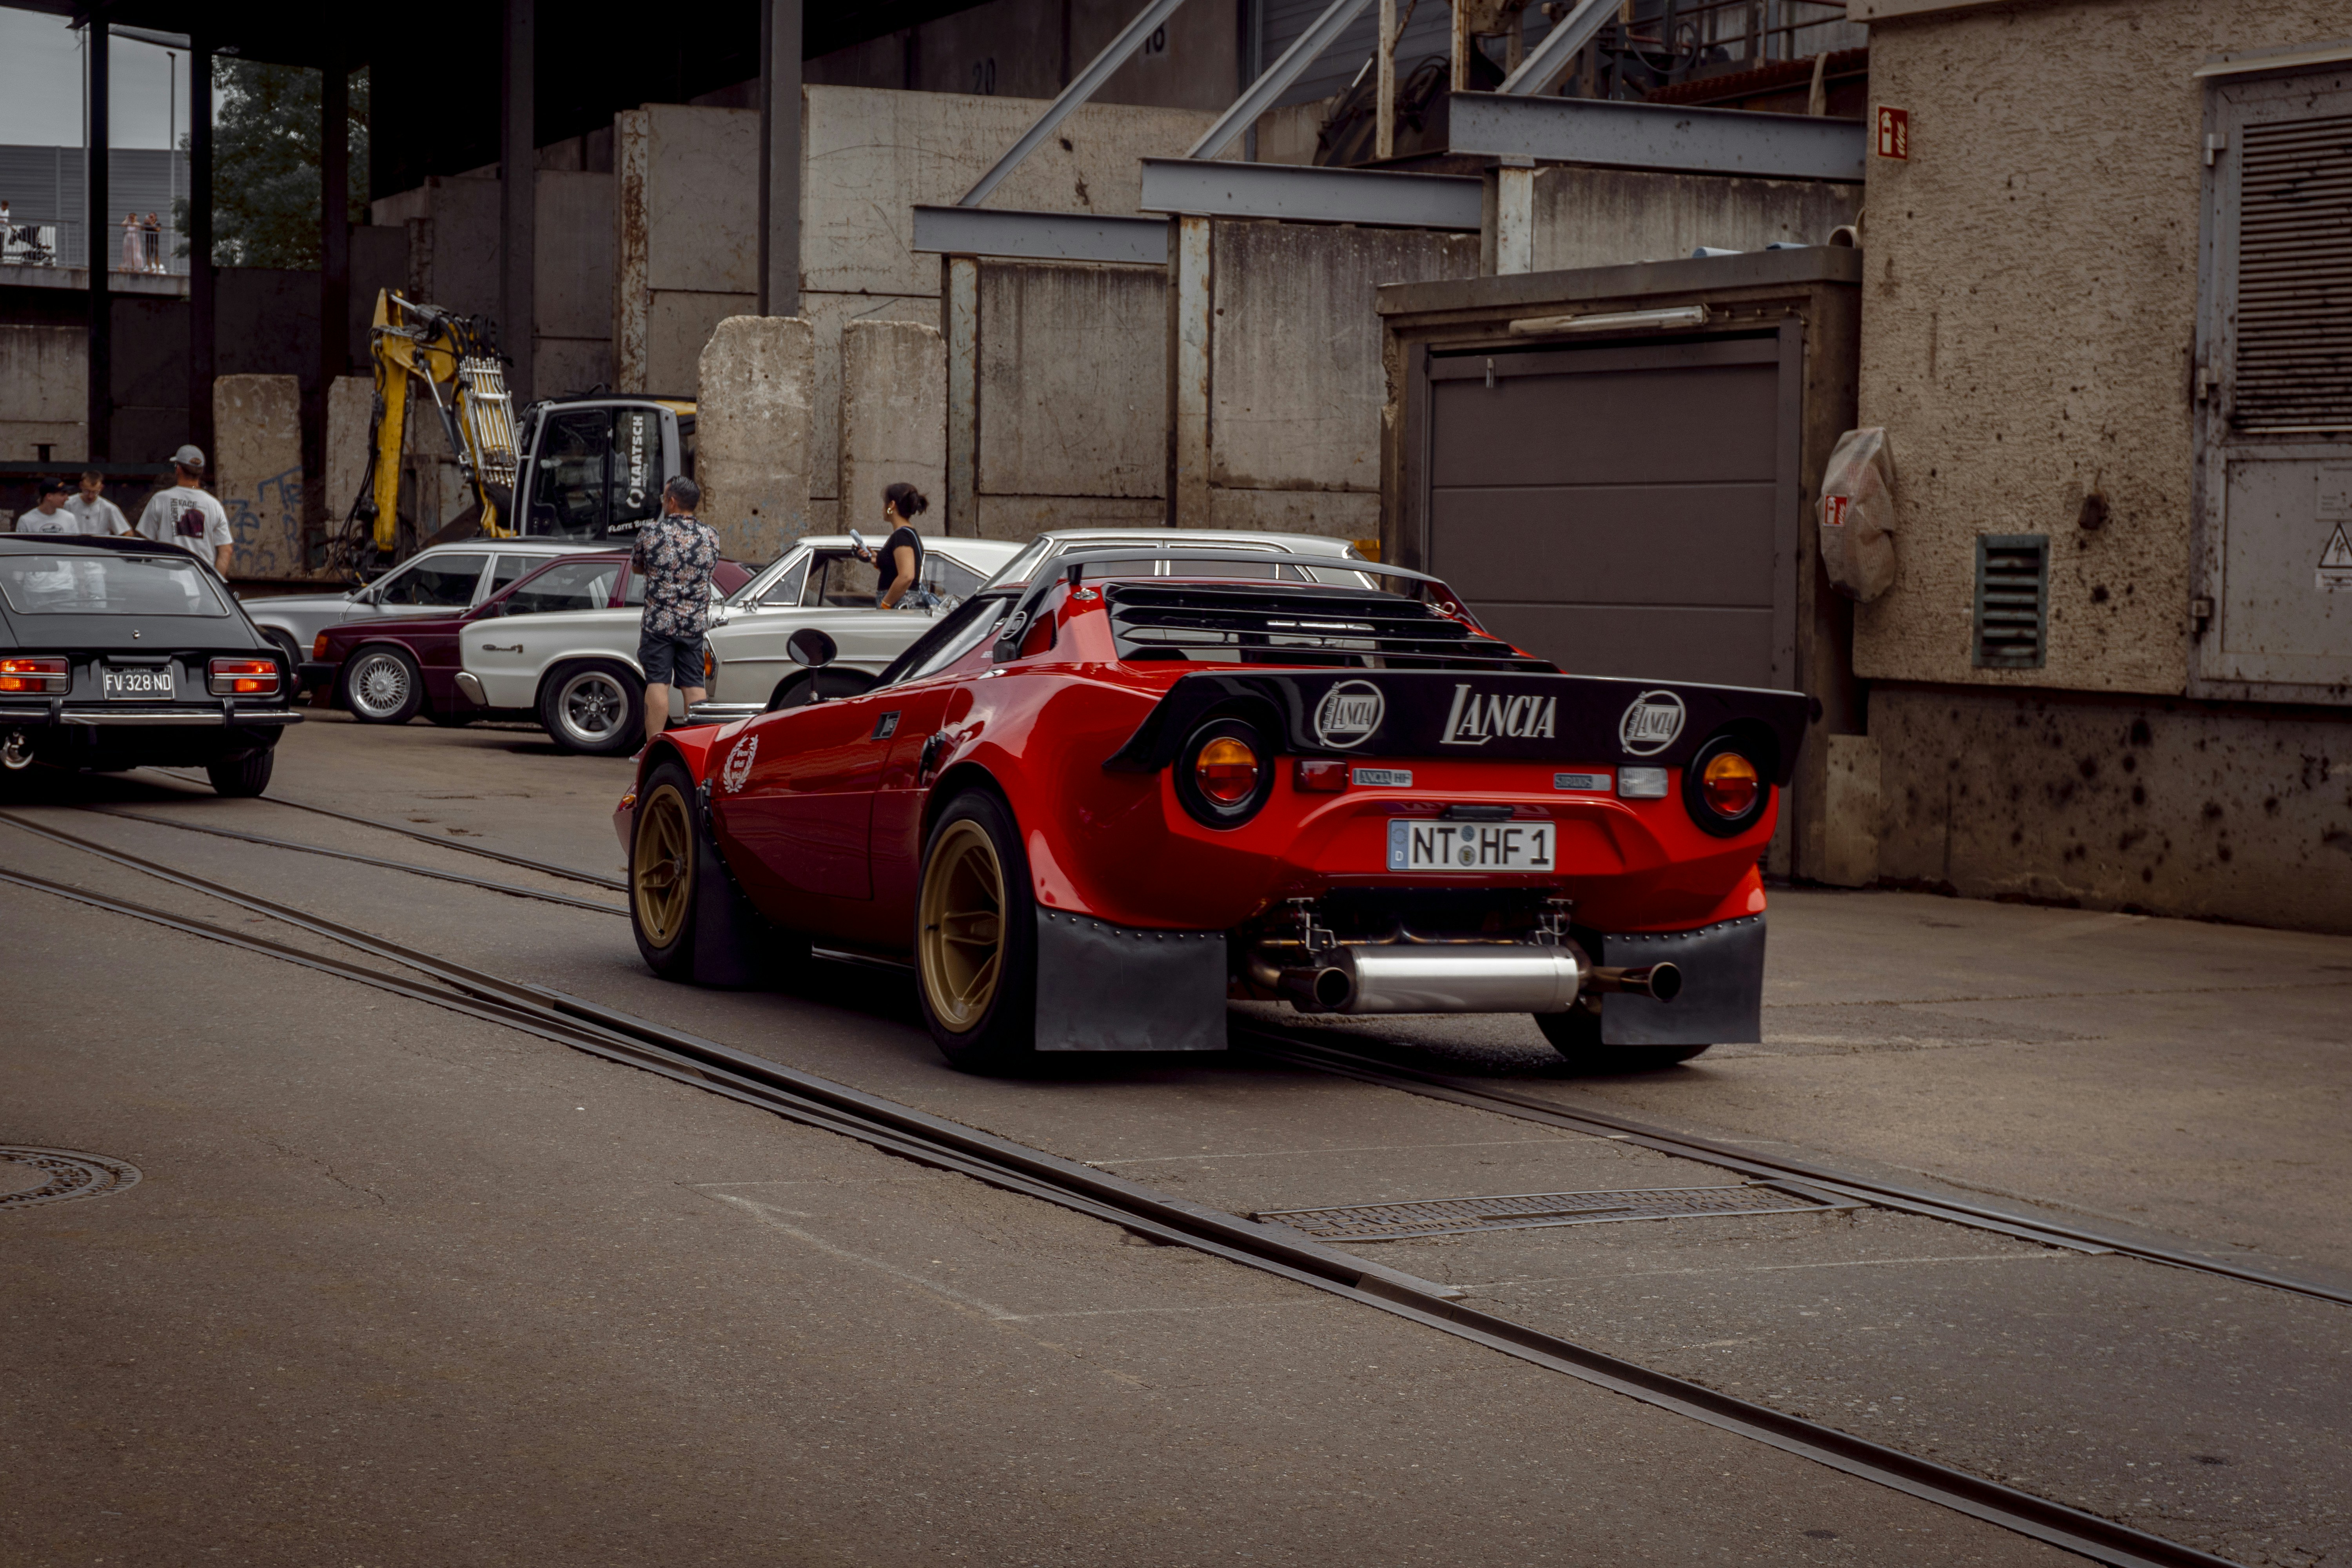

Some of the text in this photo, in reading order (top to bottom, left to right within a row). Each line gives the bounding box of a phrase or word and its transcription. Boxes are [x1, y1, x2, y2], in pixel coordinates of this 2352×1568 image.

[972, 58, 996, 95] 20
[631, 416, 643, 486] KAATSCH
[179, 499, 197, 508] FACE
[608, 522, 633, 533] FLOTTE
[1439, 684, 1557, 745] LANCIA
[1414, 827, 1456, 863] NT
